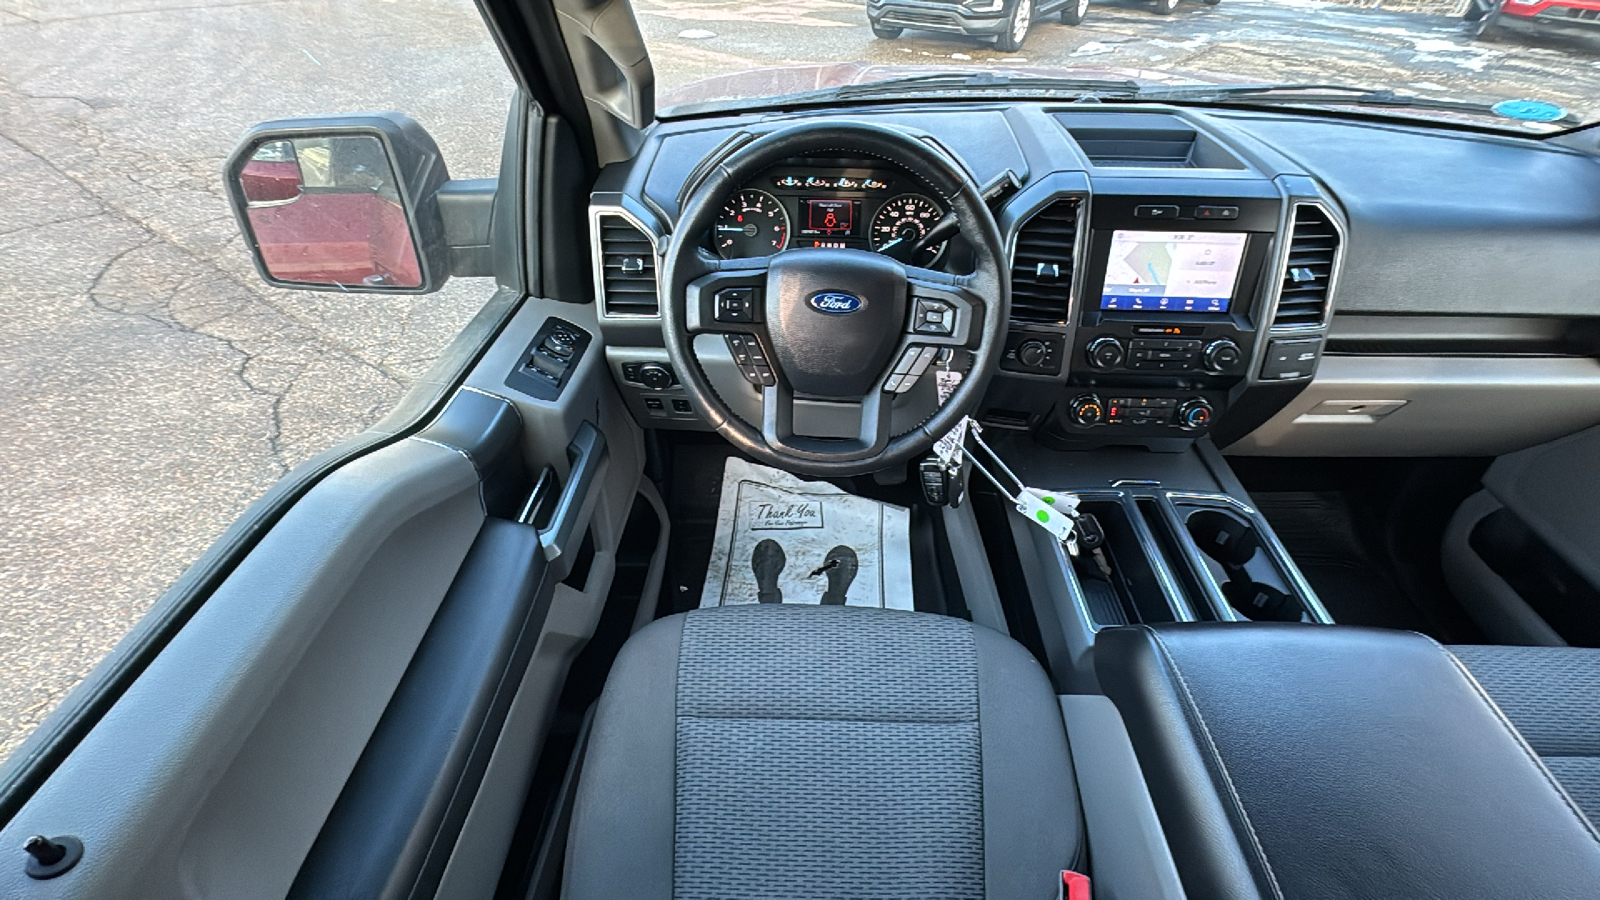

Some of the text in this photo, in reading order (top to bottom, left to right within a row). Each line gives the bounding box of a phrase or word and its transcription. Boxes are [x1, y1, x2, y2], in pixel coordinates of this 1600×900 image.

[820, 295, 852, 309] Ford
[757, 503, 816, 519] Thank You
